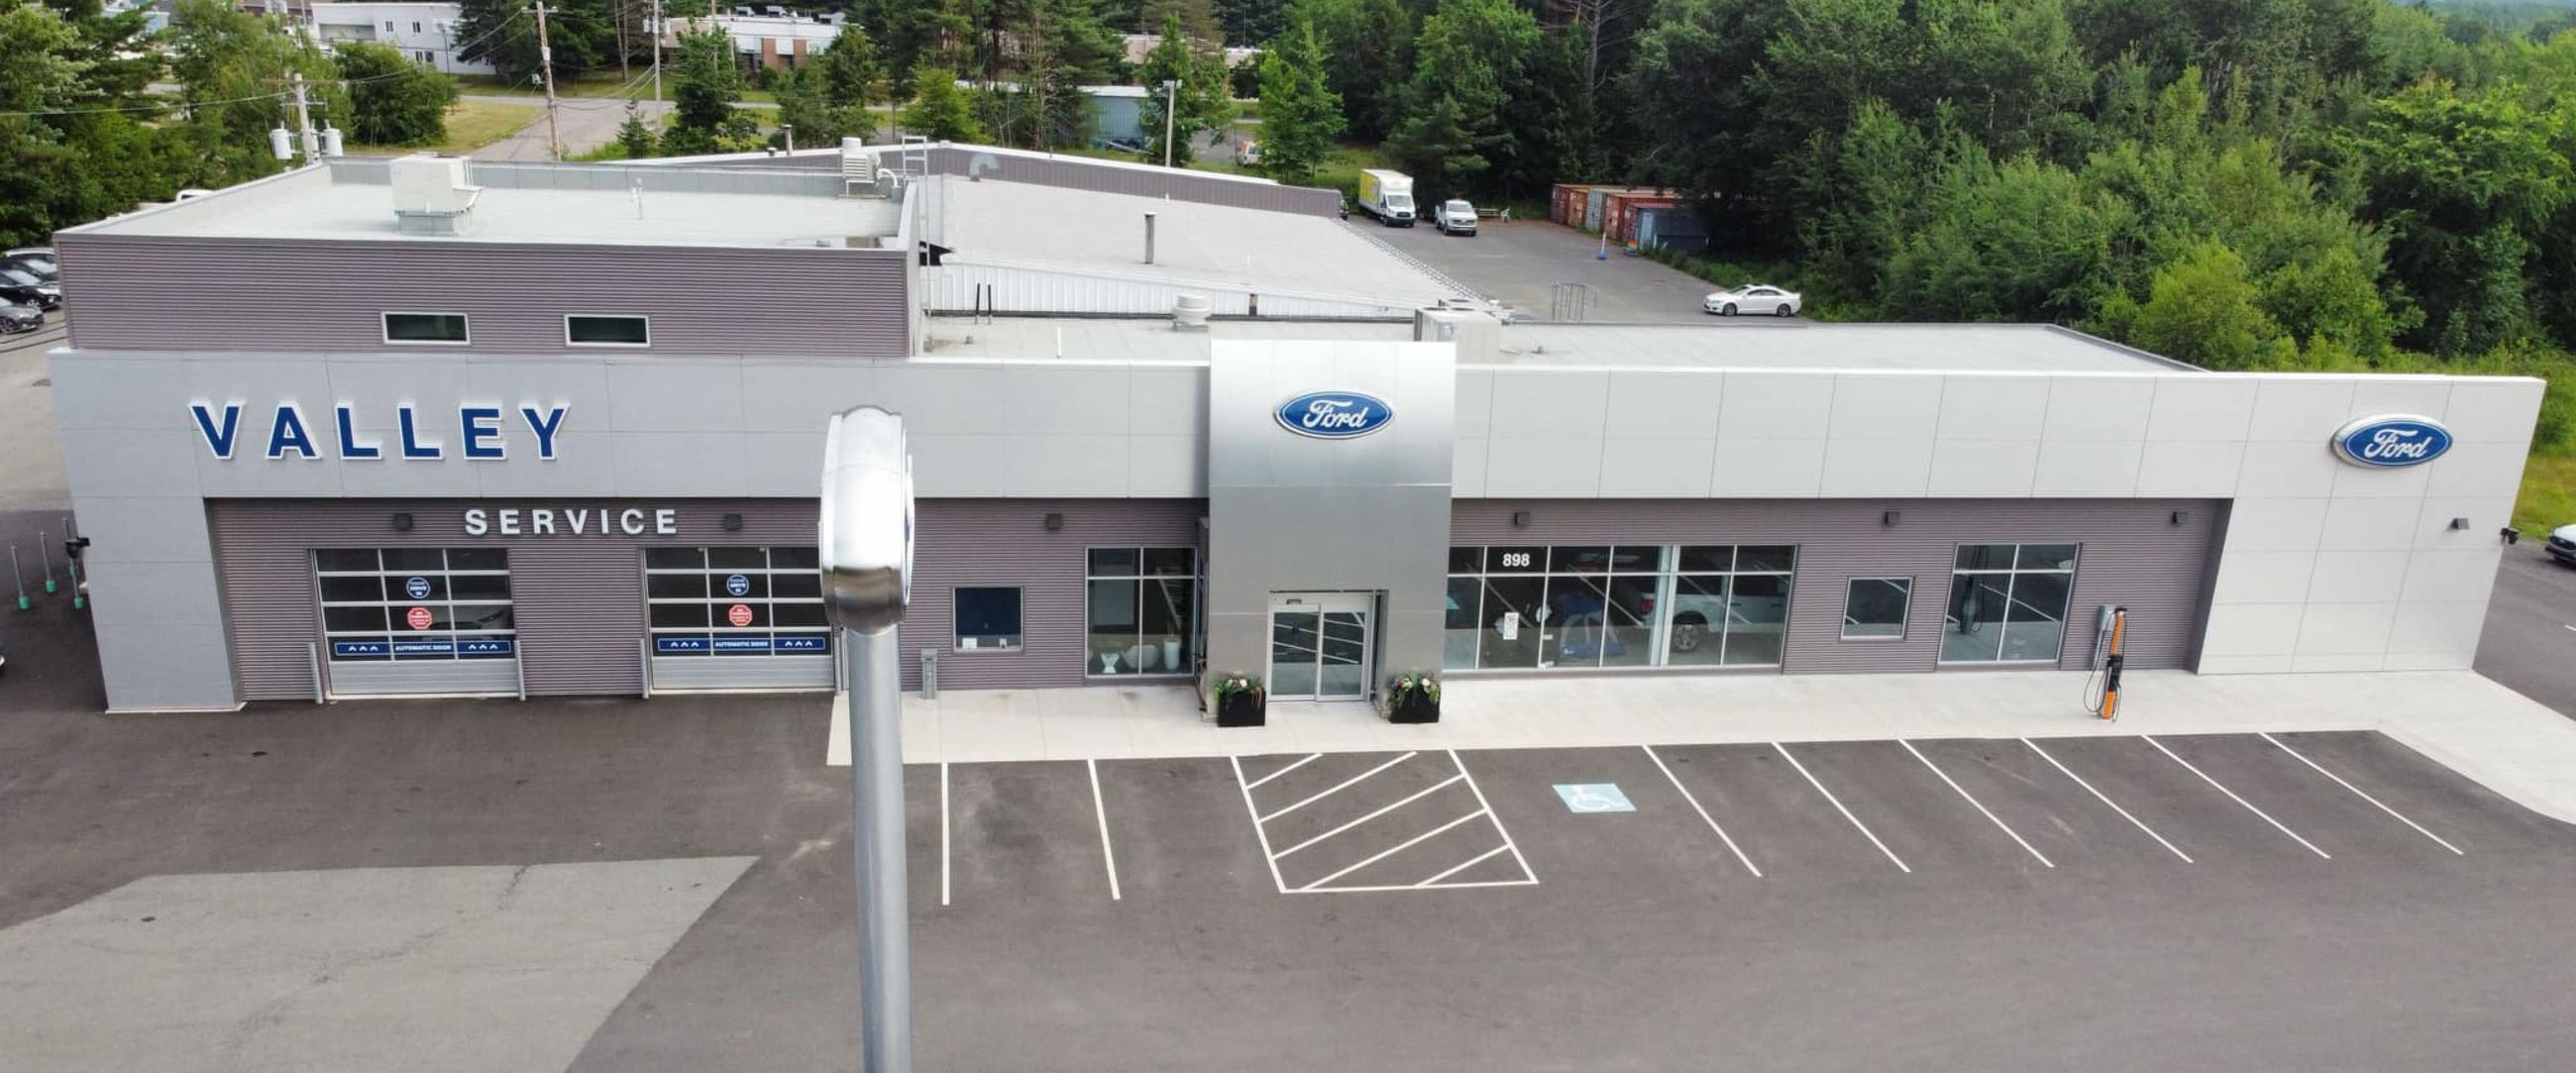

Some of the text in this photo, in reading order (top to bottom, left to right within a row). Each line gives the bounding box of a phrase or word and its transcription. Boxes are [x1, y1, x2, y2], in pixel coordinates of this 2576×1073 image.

[1303, 399, 1369, 428] Ford
[189, 400, 570, 460] VALLEY
[2364, 429, 2432, 458] Ford
[465, 508, 677, 535] SERVICE
[1502, 553, 1531, 567] 898
